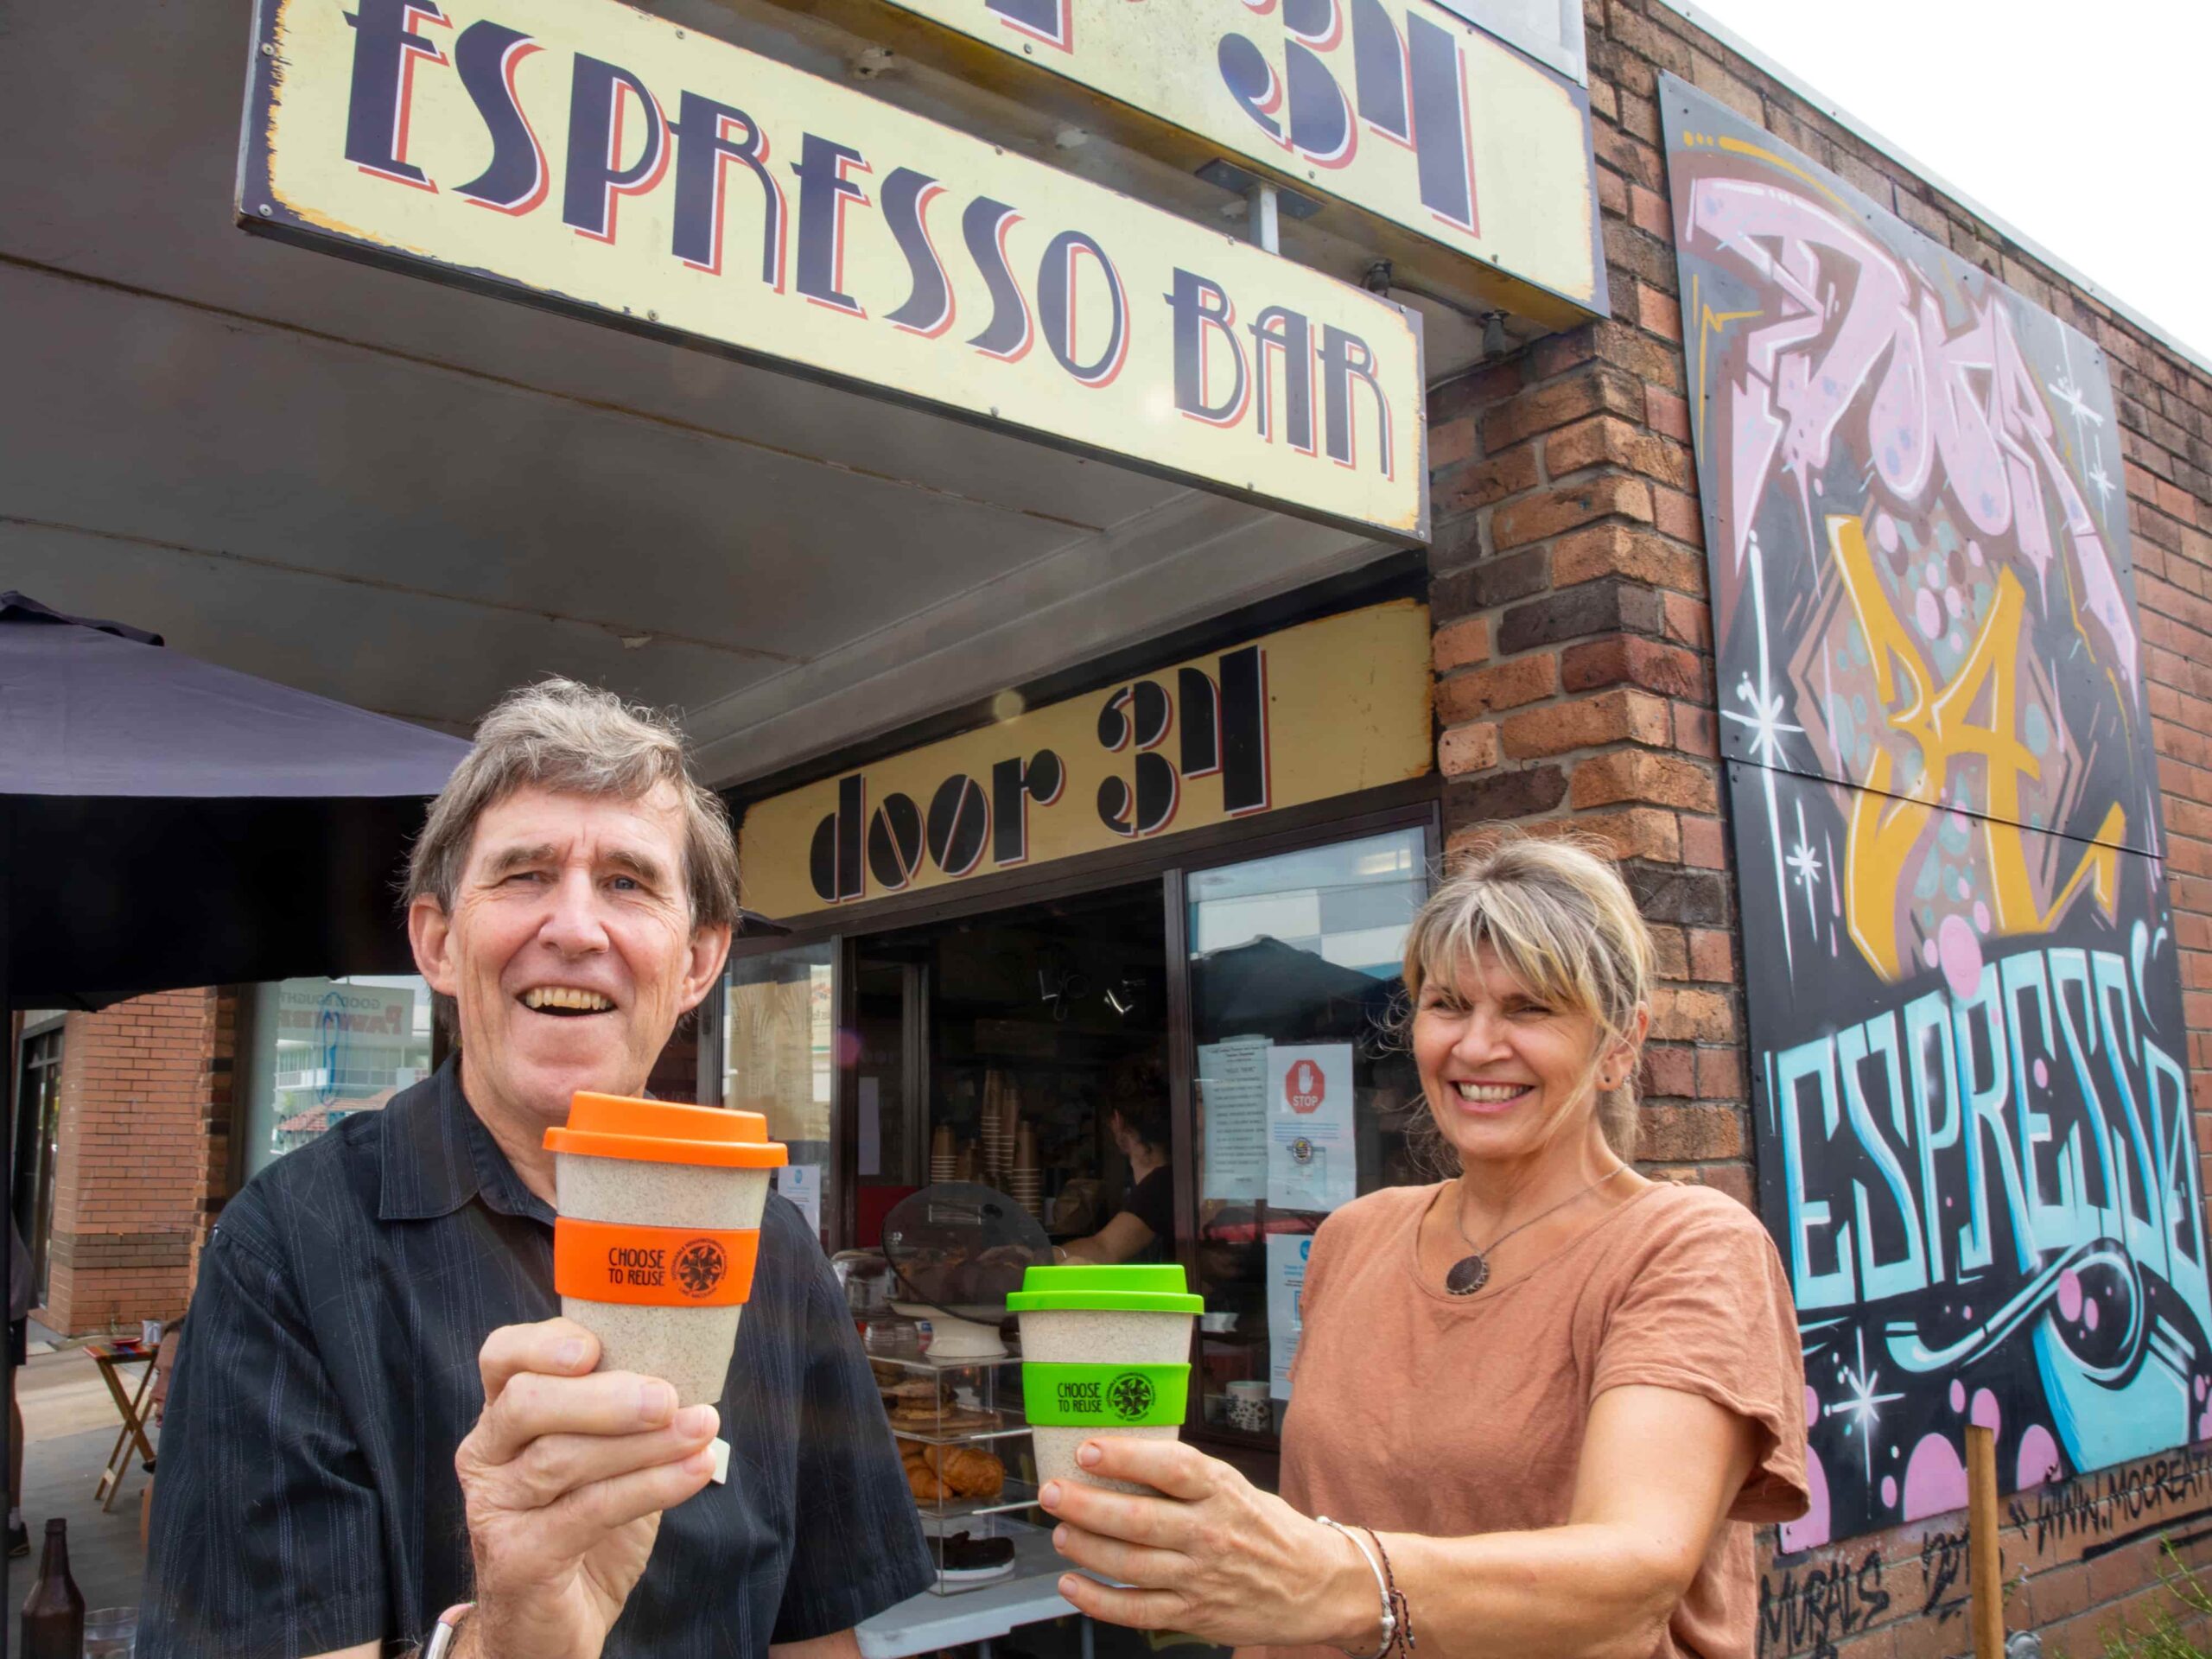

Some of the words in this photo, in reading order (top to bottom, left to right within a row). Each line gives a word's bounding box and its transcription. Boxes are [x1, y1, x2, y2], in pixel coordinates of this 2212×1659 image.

[342, 0, 1130, 390] ESPRESSO
[1163, 266, 1395, 481] BAR
[810, 748, 1066, 905] door
[1096, 645, 1273, 837] 34
[1293, 1095, 1319, 1107] STOP
[608, 1248, 665, 1269] CHOOSE
[608, 1268, 623, 1285] TO
[628, 1269, 665, 1287] REUSE
[1057, 1382, 1101, 1398] CHOOSE
[1058, 1399, 1070, 1413] TO
[1073, 1399, 1103, 1413] REUSE
